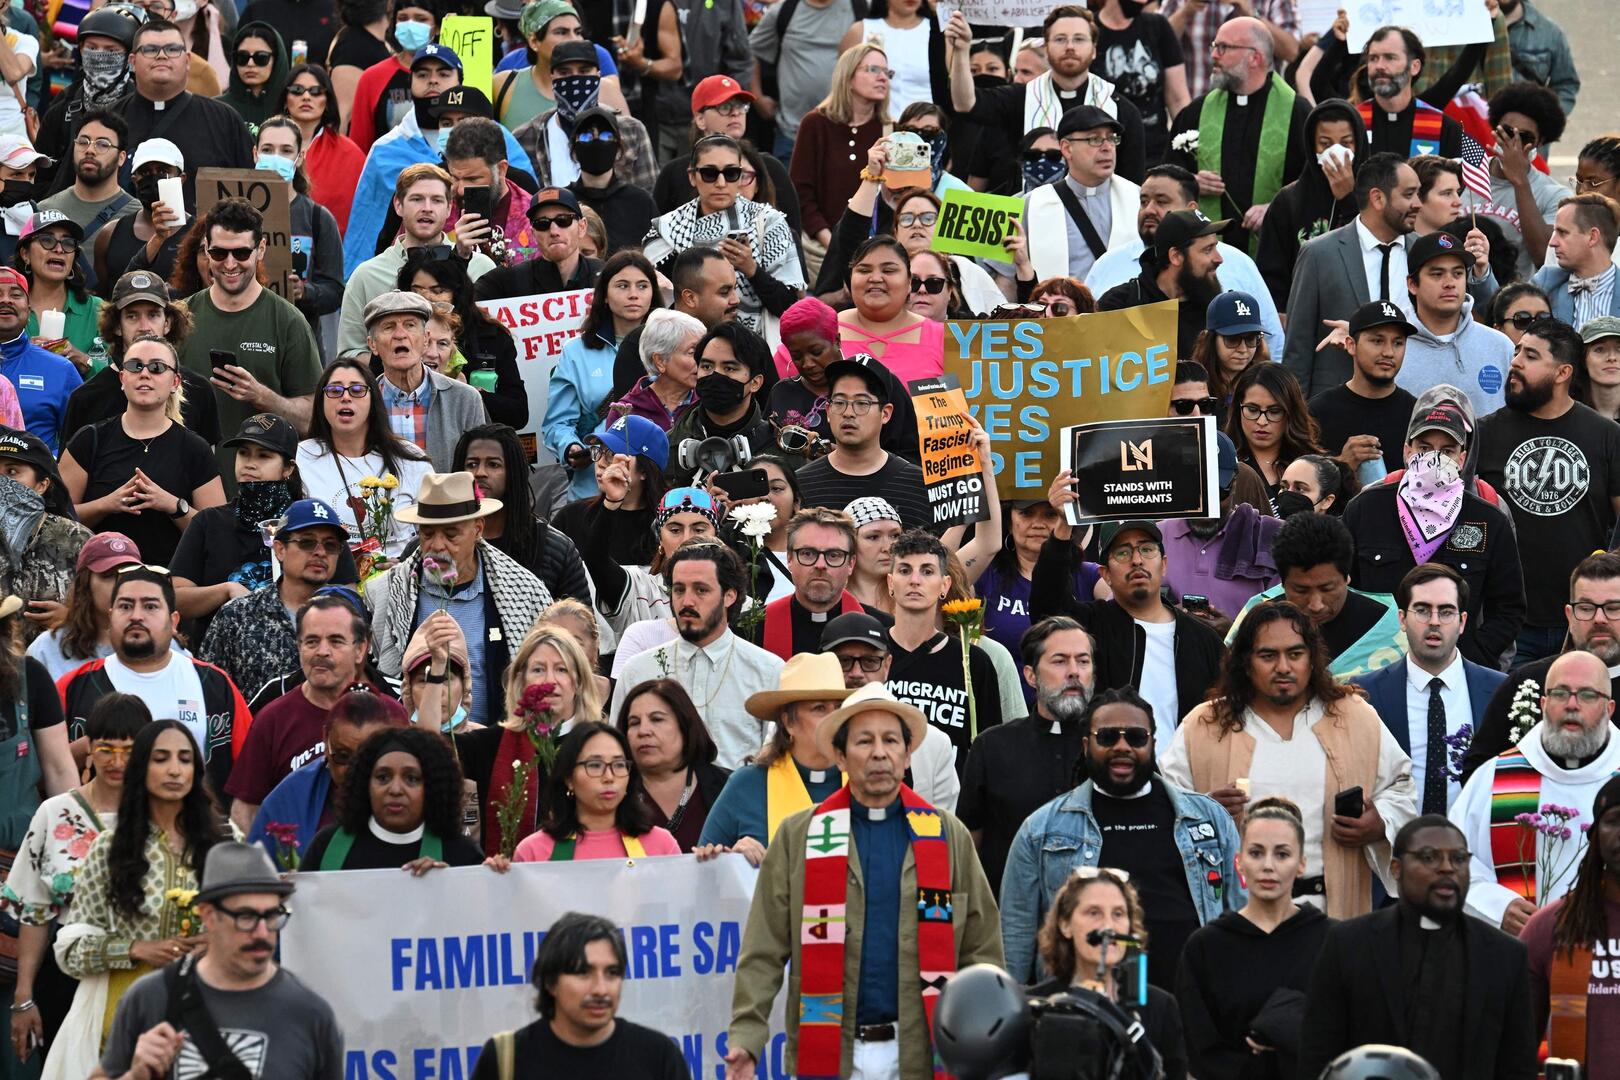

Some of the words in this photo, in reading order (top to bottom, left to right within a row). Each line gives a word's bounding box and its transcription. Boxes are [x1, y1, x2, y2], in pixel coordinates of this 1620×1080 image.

[217, 181, 271, 213] NO
[938, 202, 1020, 246] RESIST
[1235, 300, 1251, 316] LA
[1380, 302, 1397, 318] LA
[947, 322, 1044, 360] YES
[964, 343, 1170, 400] JUSTICE
[929, 396, 948, 409] The
[926, 413, 964, 431] Trump
[923, 429, 972, 454] Fascist
[1516, 441, 1537, 460] HIGH
[1538, 439, 1580, 459] VOLTAGE
[925, 453, 975, 477] Regime
[928, 483, 955, 502] MUST
[956, 477, 982, 496] GO
[1103, 482, 1145, 493] STANDS
[1145, 480, 1173, 491] WITH
[1540, 491, 1559, 500] 1976
[933, 495, 981, 523] NOW!!!
[1106, 493, 1173, 505] IMMIGRANTS
[1516, 494, 1541, 513] ROCK
[1545, 505, 1552, 513] &
[1554, 495, 1578, 512] ROLL
[312, 502, 329, 519] LA
[997, 595, 1030, 616] PA
[884, 680, 969, 705] MIGRANT
[179, 711, 198, 723] USA
[1128, 823, 1158, 832] promise.
